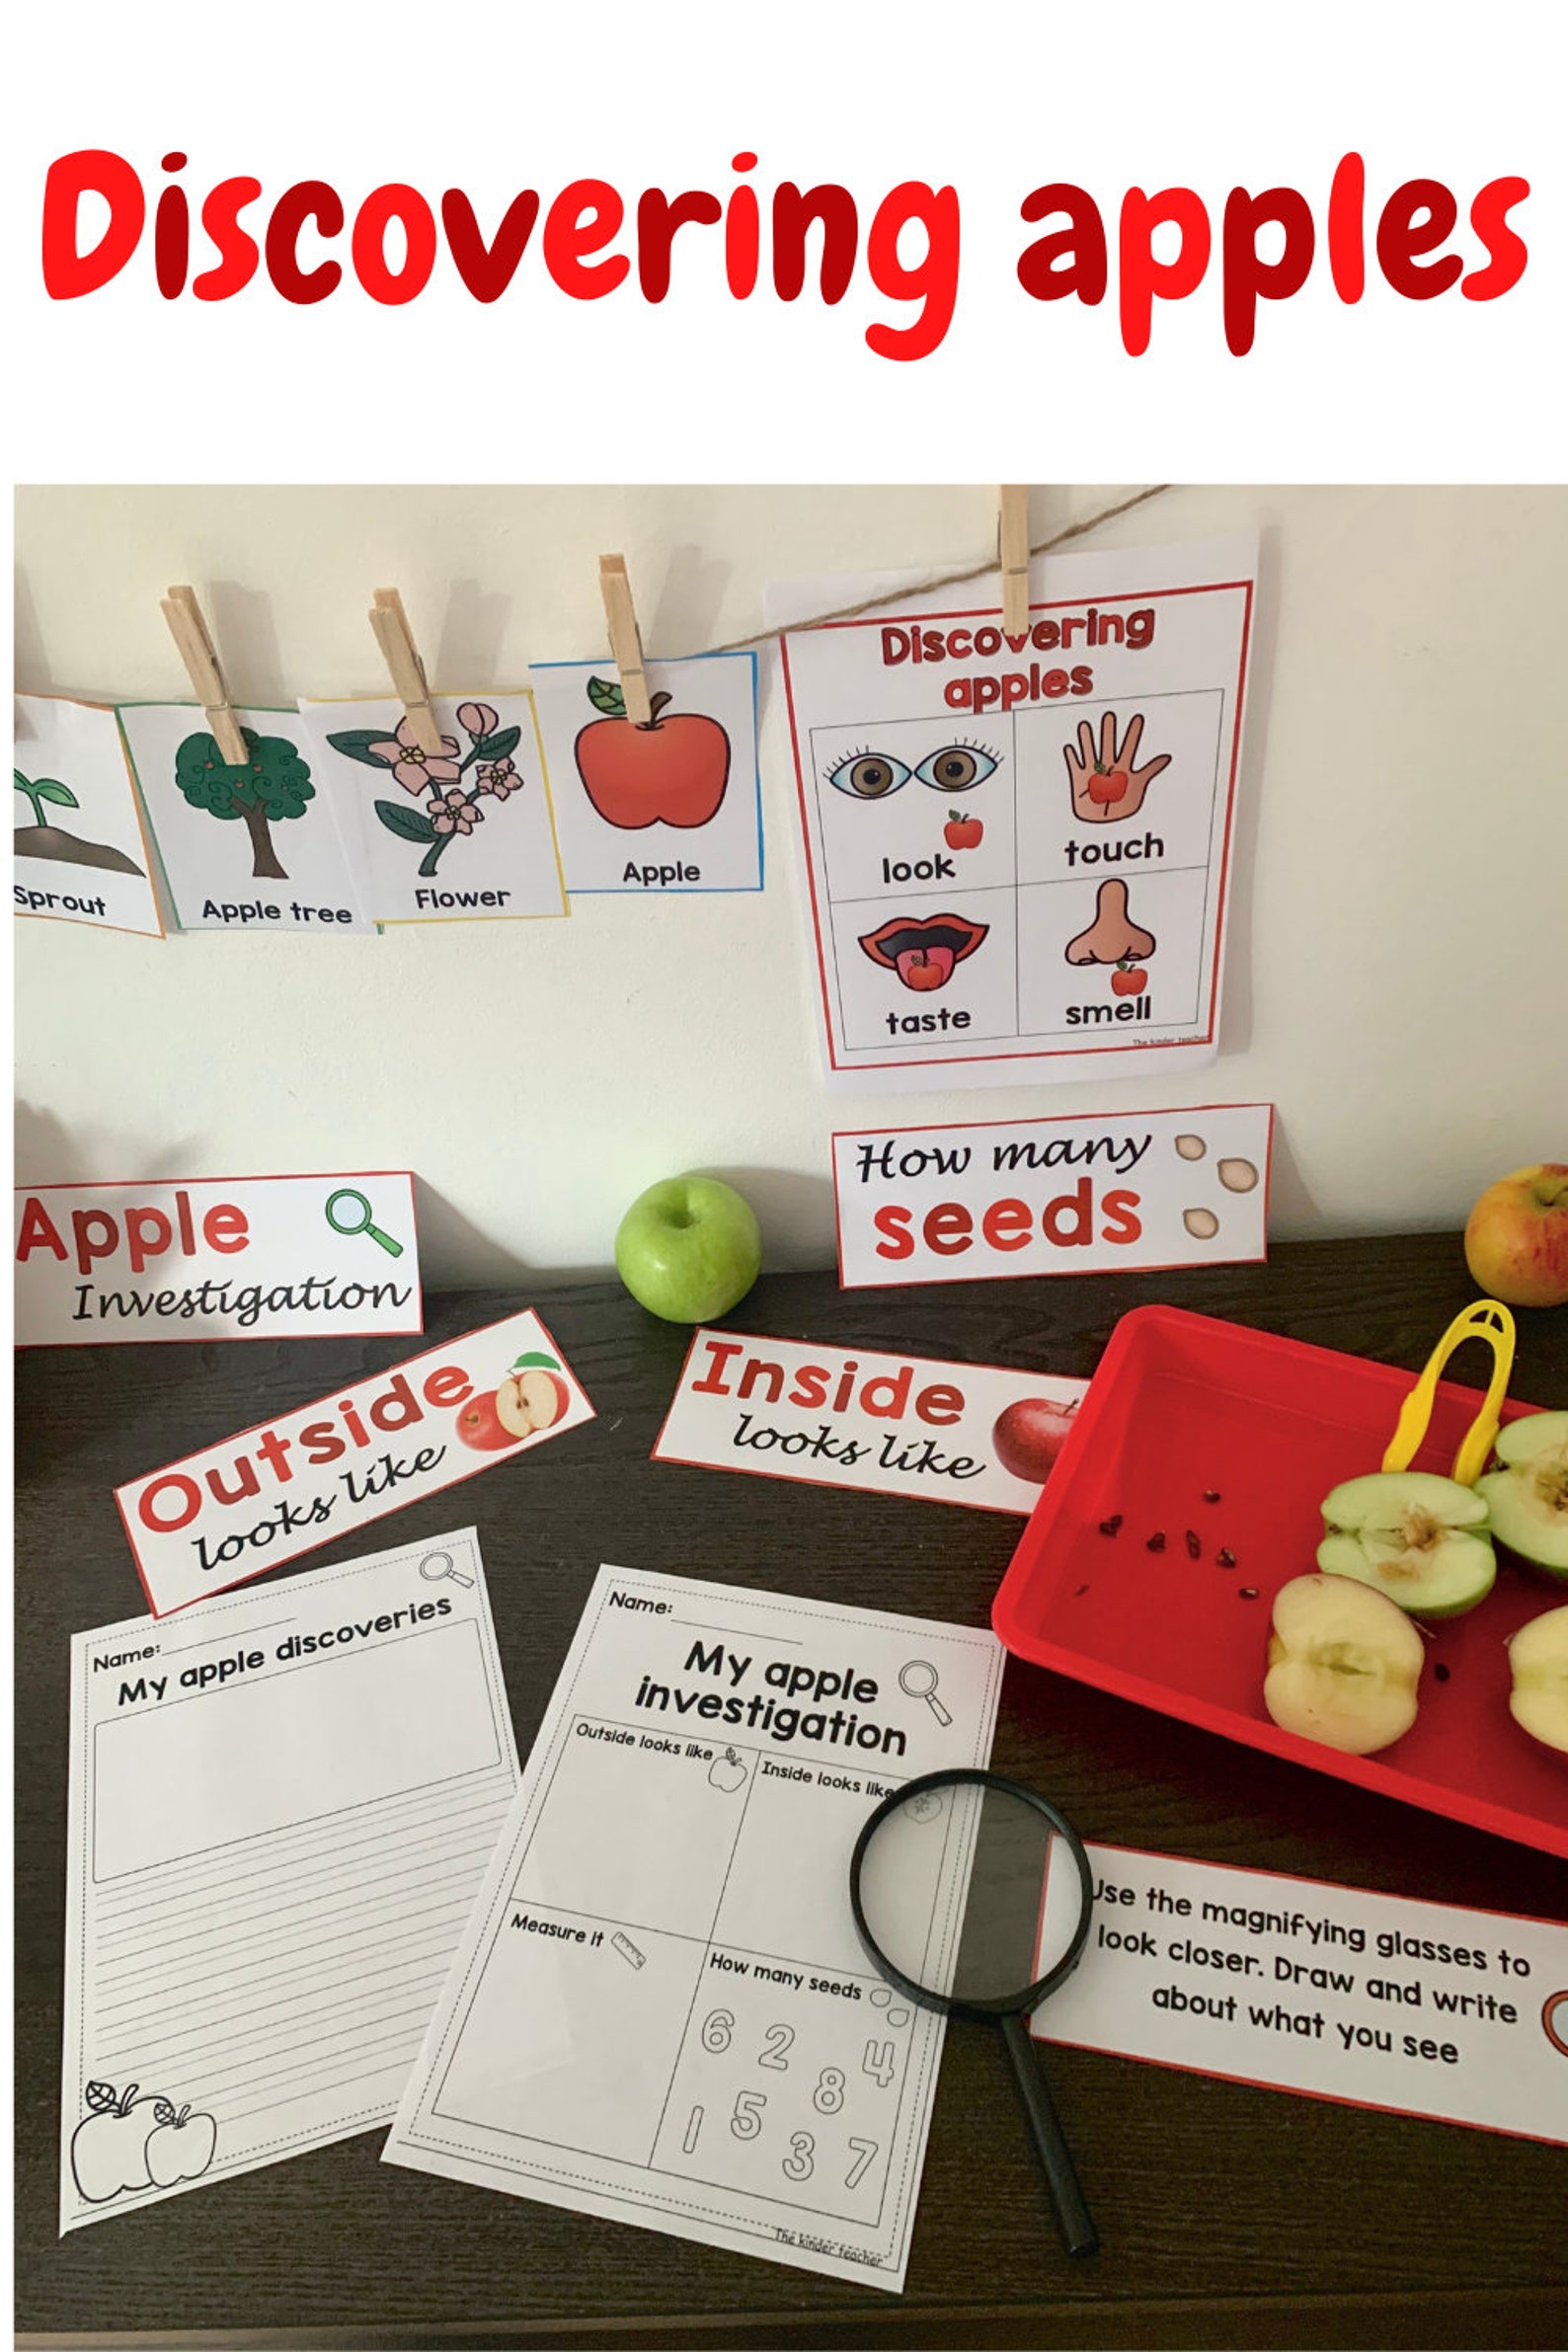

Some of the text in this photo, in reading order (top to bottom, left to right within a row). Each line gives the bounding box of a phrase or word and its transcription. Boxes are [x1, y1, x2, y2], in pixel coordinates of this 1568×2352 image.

[881, 608, 1155, 666] Discovering
[944, 664, 1094, 714] apples
[883, 853, 957, 884] look
[1064, 833, 1164, 866] touch
[416, 887, 510, 909] Flower
[622, 861, 700, 887] Apple
[14, 885, 107, 917] Sprout
[201, 899, 353, 926] Apple tree
[887, 1006, 972, 1036] taste
[1066, 996, 1152, 1025] smell
[857, 1134, 1152, 1183] How many
[15, 1190, 250, 1276] Apple
[873, 1176, 1142, 1260] seeds
[72, 1276, 413, 1326] Investigation
[691, 1341, 966, 1426] Inside
[137, 1365, 475, 1532] Outside
[733, 1414, 986, 1480] looks like
[192, 1445, 447, 1570] looks like
[608, 1592, 673, 1615] Name:
[94, 1642, 161, 1673] Name:
[118, 1596, 452, 1706] My apple discoveries
[684, 1640, 879, 1703] My apple
[635, 1676, 906, 1757] investigation
[576, 1722, 714, 1762] Outside looks like
[761, 1761, 895, 1799] Inside looks like
[510, 1913, 604, 1947] Measure it
[1091, 1879, 1530, 1978] Use the magnifying glasses to
[710, 1952, 862, 1999] How many seeds
[1098, 1925, 1519, 2023] look closer. Draw and write
[701, 2008, 735, 2053] 6
[758, 2024, 795, 2071] 2
[1152, 1986, 1459, 2065] about what you see
[862, 2040, 895, 2087] 4
[813, 2067, 845, 2114] 8
[731, 2090, 767, 2141] 5
[782, 2131, 815, 2181] 3
[845, 2137, 878, 2189] 7
[772, 2228, 796, 2245] The
[799, 2234, 834, 2255] kinder
